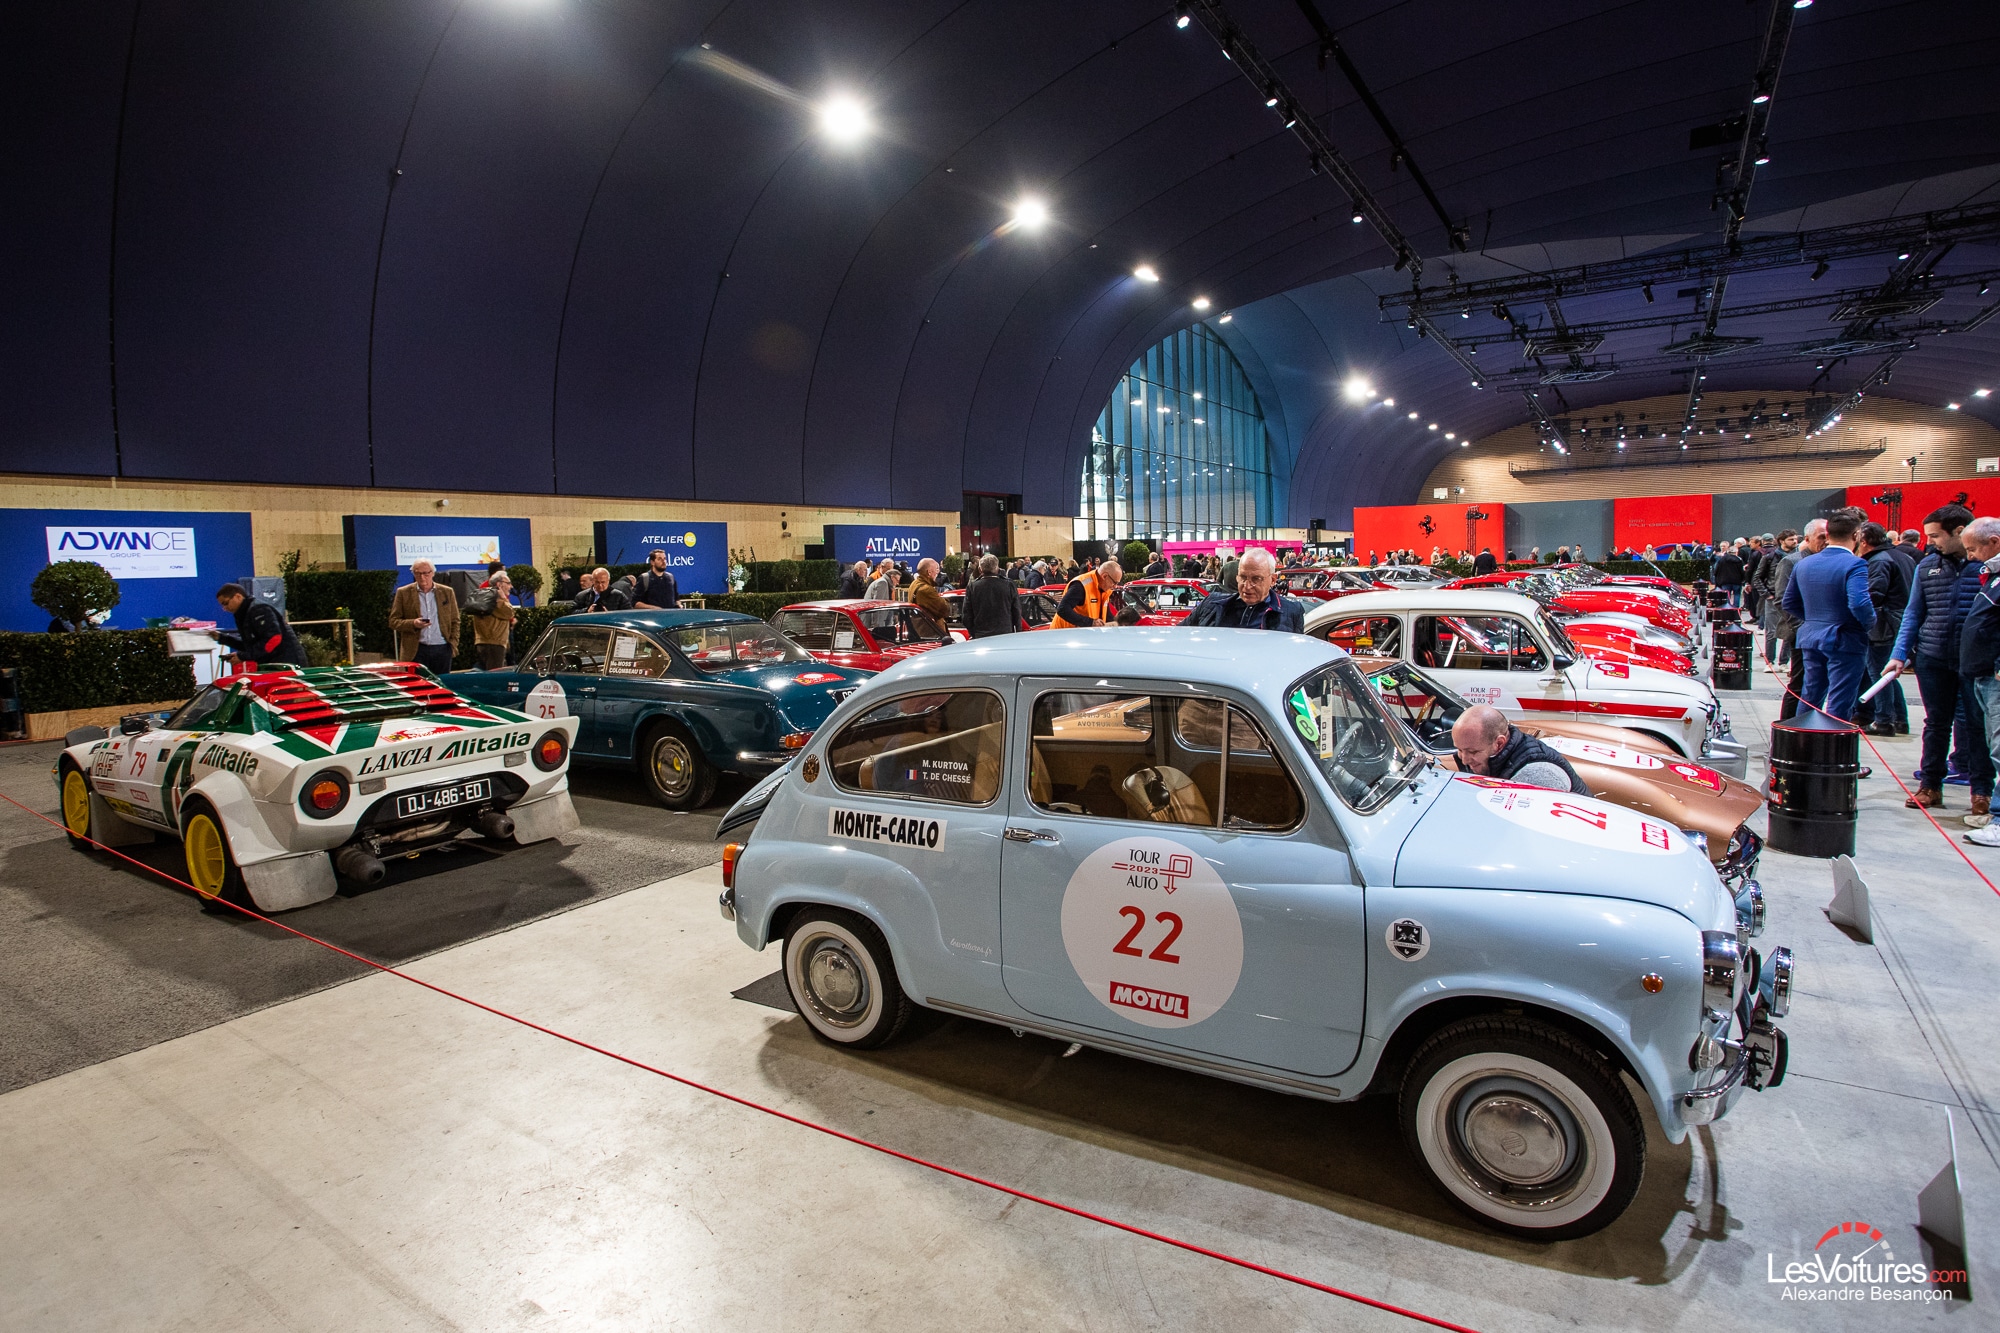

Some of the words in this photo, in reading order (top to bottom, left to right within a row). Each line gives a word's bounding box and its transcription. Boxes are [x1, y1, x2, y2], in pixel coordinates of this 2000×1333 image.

[58, 531, 188, 551] ADVANCE
[400, 542, 434, 554] Butard
[444, 541, 483, 553] Enescot
[641, 535, 684, 544] ATELIER
[865, 537, 920, 552] ATLAND
[1718, 661, 1740, 669] MOTUL
[540, 704, 556, 719] 25
[437, 731, 533, 761] Alitalia
[130, 751, 147, 777] 79
[199, 744, 259, 777] Alitalia
[357, 746, 434, 777] LANCIA
[922, 759, 931, 768] M.
[932, 760, 969, 771] KURTOVA
[922, 771, 929, 780] T.
[930, 772, 940, 781] DE
[942, 774, 971, 784] CHESSÉ
[407, 782, 483, 813] DJ-486-ED
[1550, 802, 1607, 830] 22
[833, 810, 939, 848] MONTE-CARLO
[1129, 849, 1160, 864] TOUR
[1129, 864, 1158, 875] 2023
[1126, 875, 1158, 890] AUTO
[1113, 905, 1183, 964] 22
[1113, 985, 1186, 1015] MOTUL
